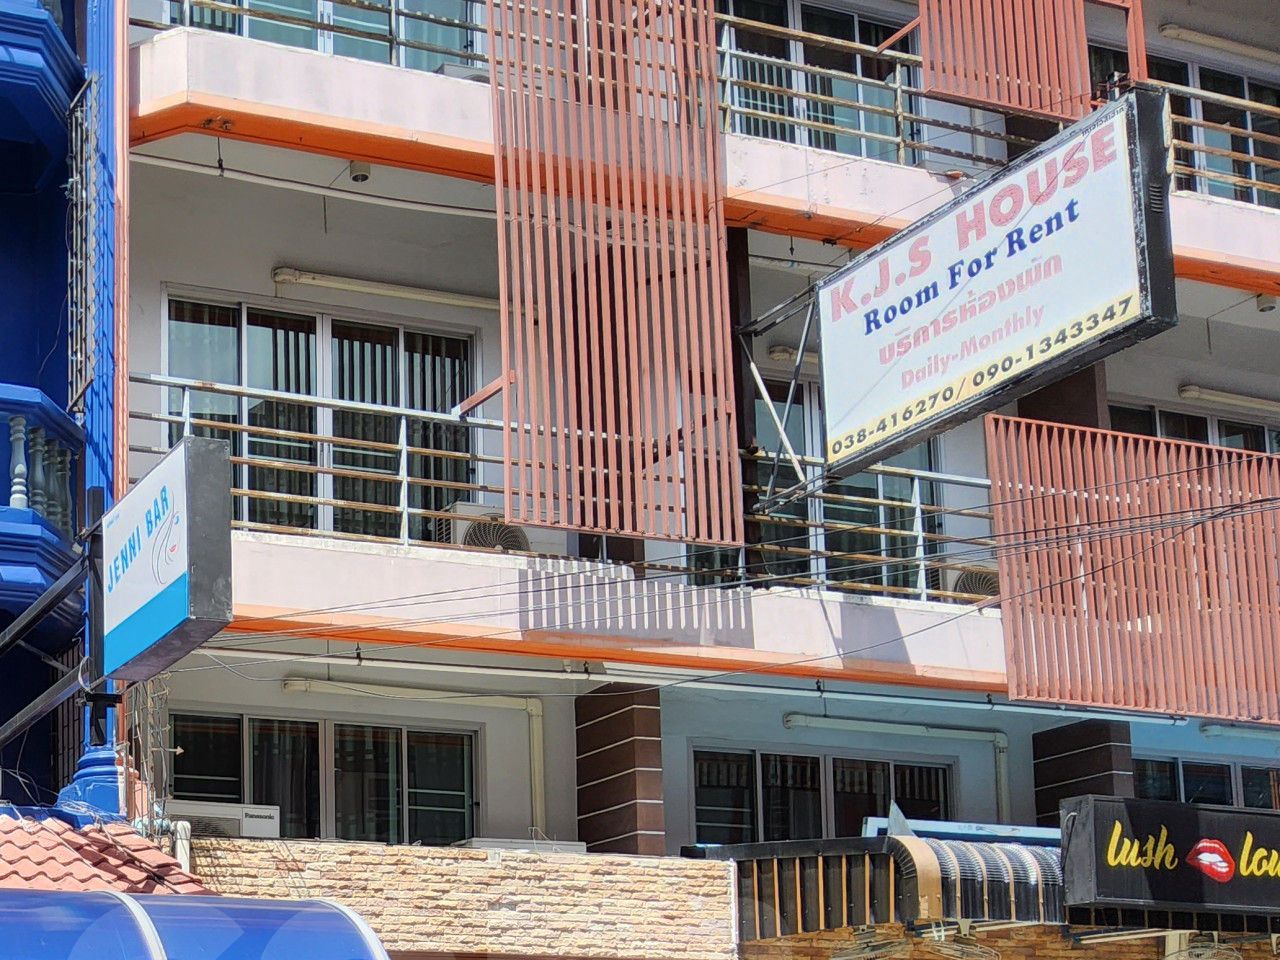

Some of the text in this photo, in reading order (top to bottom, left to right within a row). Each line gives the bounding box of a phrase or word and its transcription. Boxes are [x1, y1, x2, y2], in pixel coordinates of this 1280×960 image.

[830, 122, 1118, 323] K.J.S HOUSE
[863, 195, 1080, 336] Room For Rent
[901, 304, 1045, 390] Daily-Monthly
[972, 295, 1134, 388] 090-1343347
[107, 525, 142, 593] JENNI
[144, 485, 170, 537] BAR
[244, 812, 275, 820] Panasonic
[1106, 820, 1179, 870] lush
